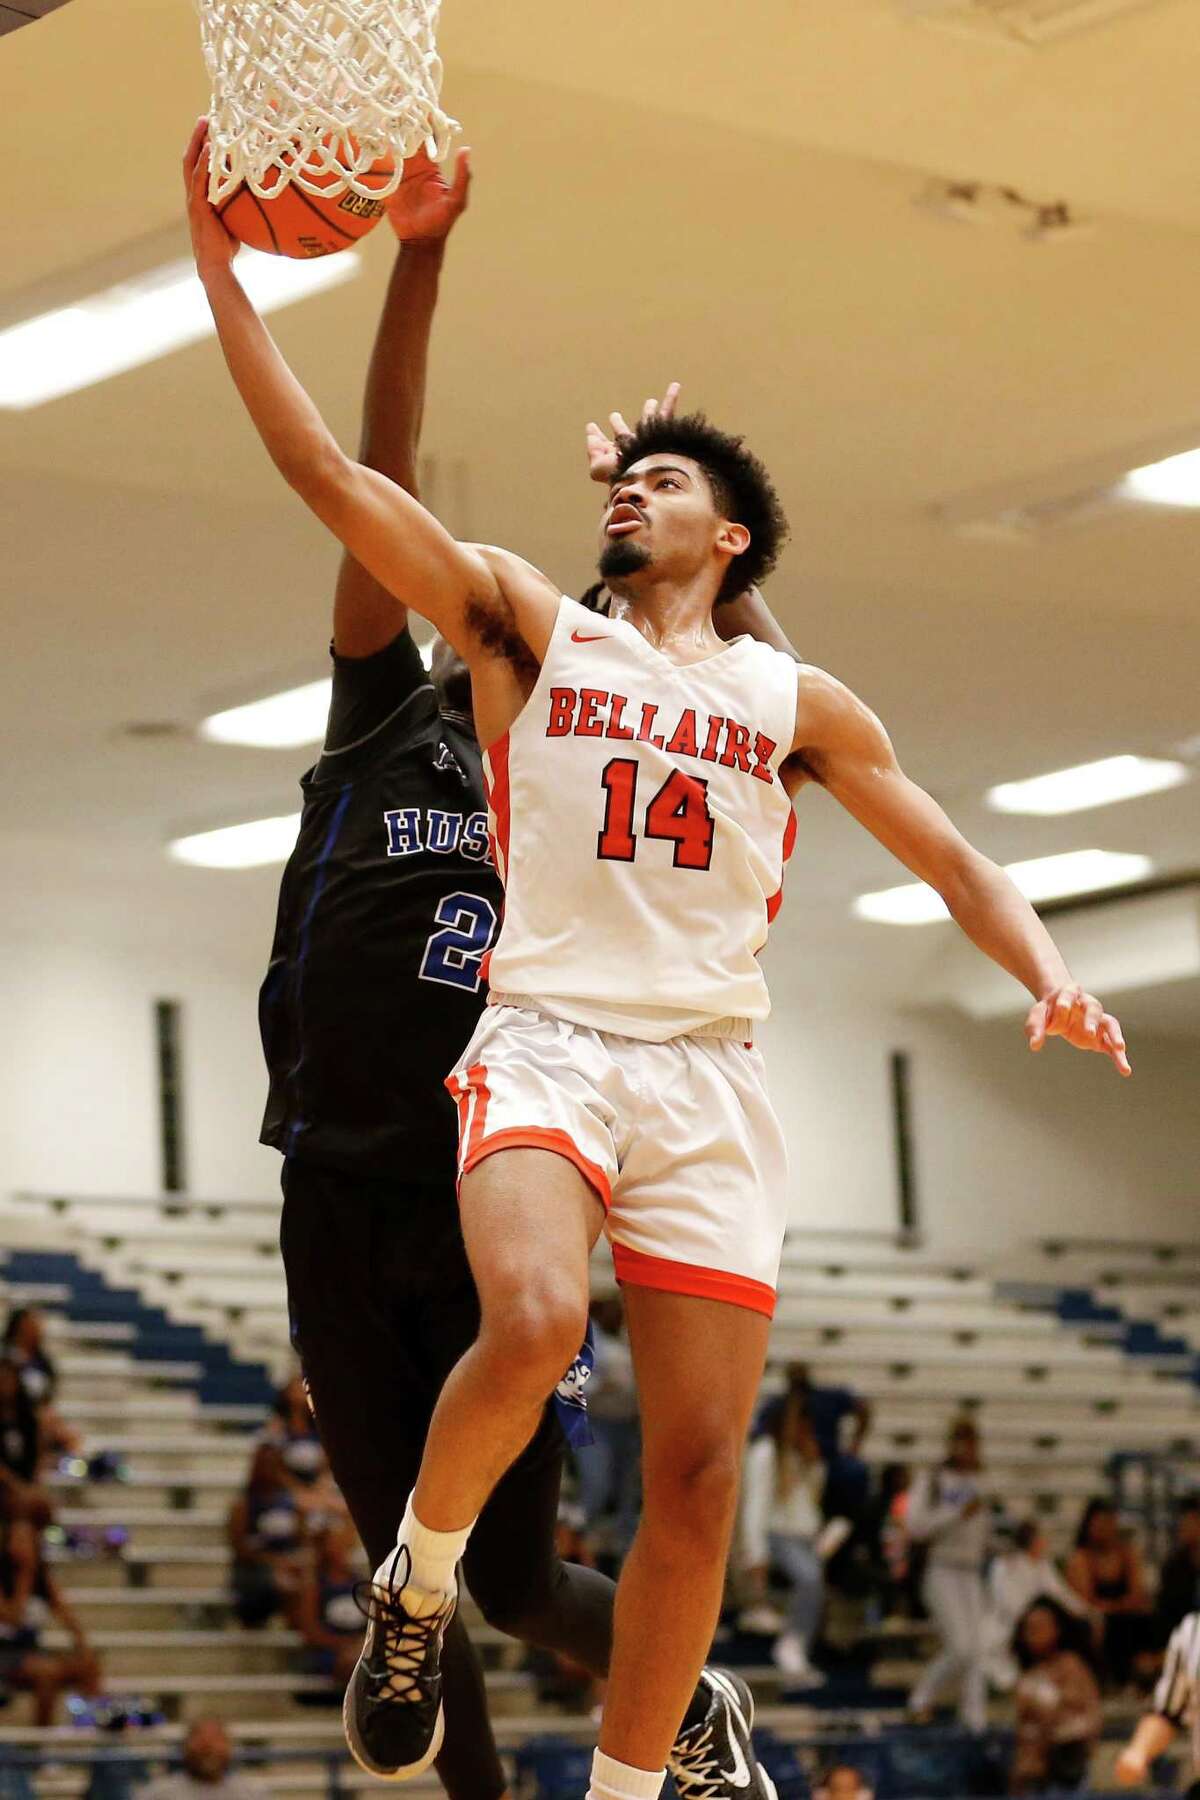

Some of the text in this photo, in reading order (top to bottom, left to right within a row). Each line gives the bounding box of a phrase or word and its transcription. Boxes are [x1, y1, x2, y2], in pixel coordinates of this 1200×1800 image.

[545, 687, 777, 784] BELLAIRE
[383, 807, 495, 865] HUS
[597, 757, 715, 871] 14
[418, 891, 497, 993] 2
